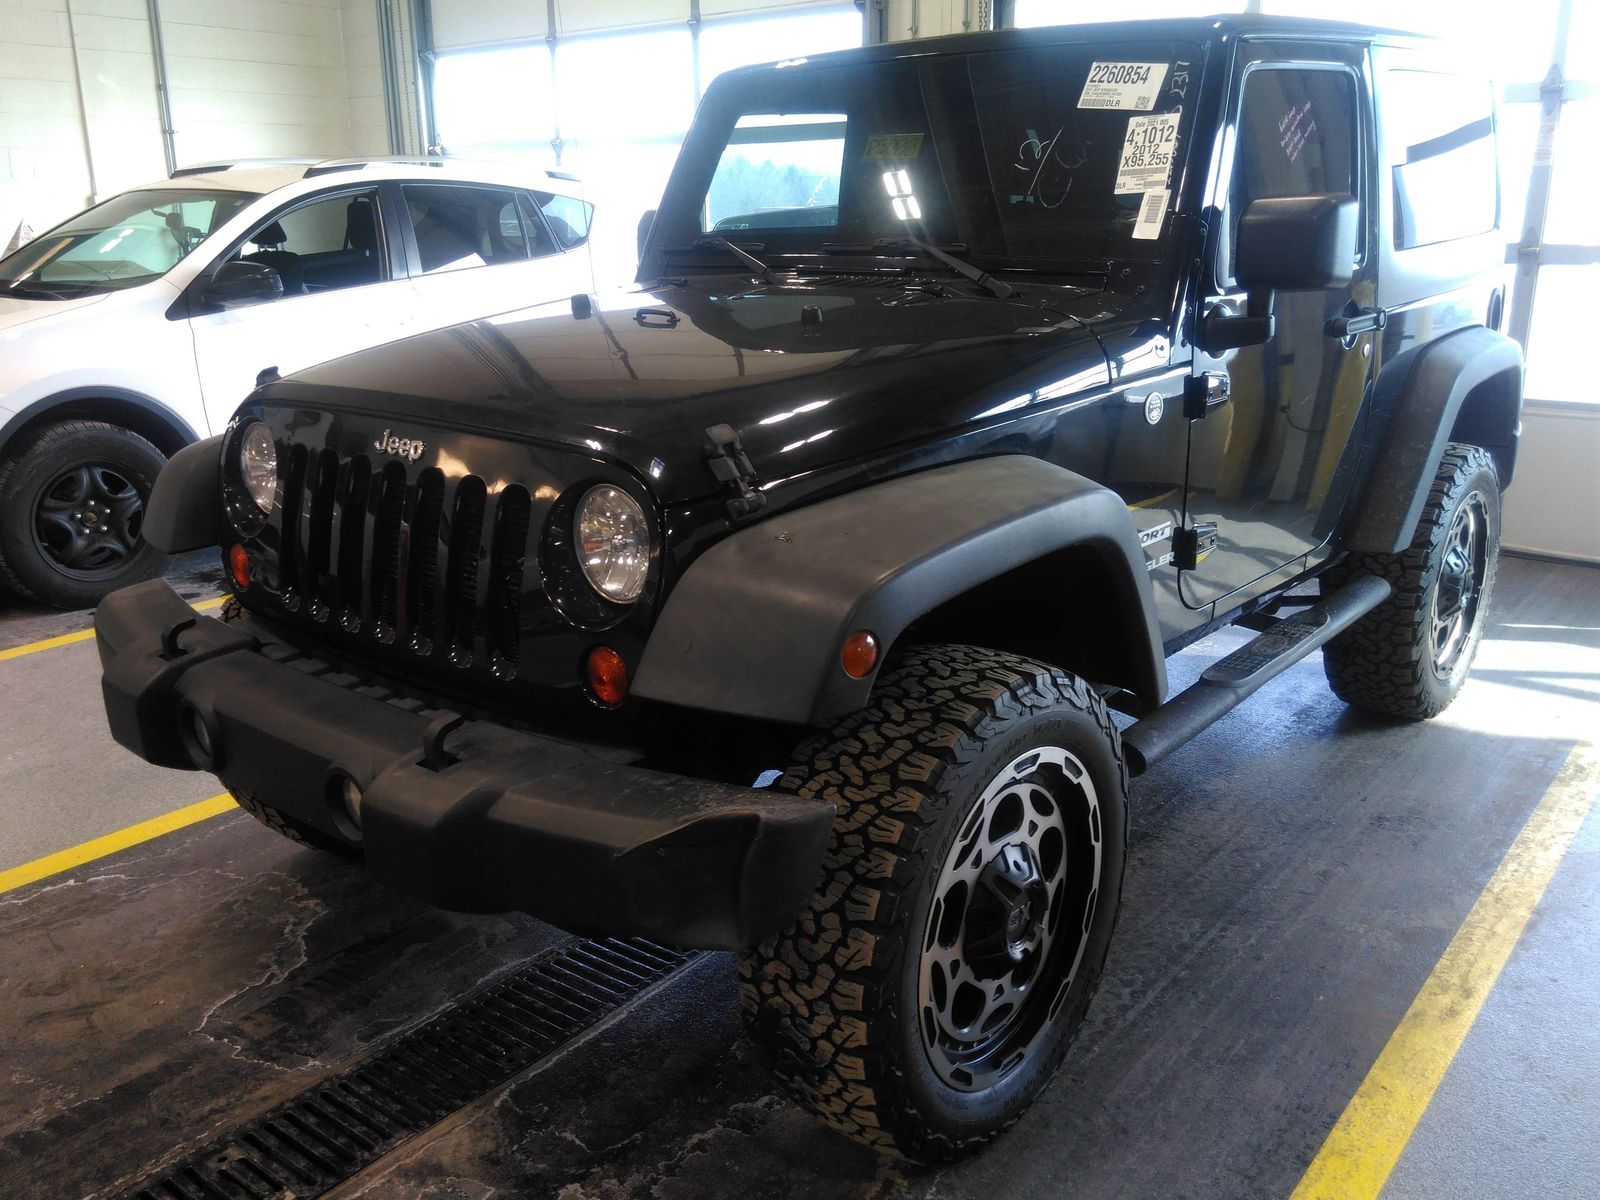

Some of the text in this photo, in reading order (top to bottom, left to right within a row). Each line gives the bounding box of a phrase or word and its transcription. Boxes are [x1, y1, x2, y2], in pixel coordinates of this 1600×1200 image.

[1089, 65, 1151, 84] 2260854
[1105, 99, 1121, 107] DLR
[1147, 119, 1159, 127] 2021
[1127, 125, 1174, 146] 4:1012
[1132, 143, 1160, 156] 2012
[1115, 182, 1126, 190] DLR
[374, 429, 423, 461] Jeep
[1140, 526, 1168, 544] ORT
